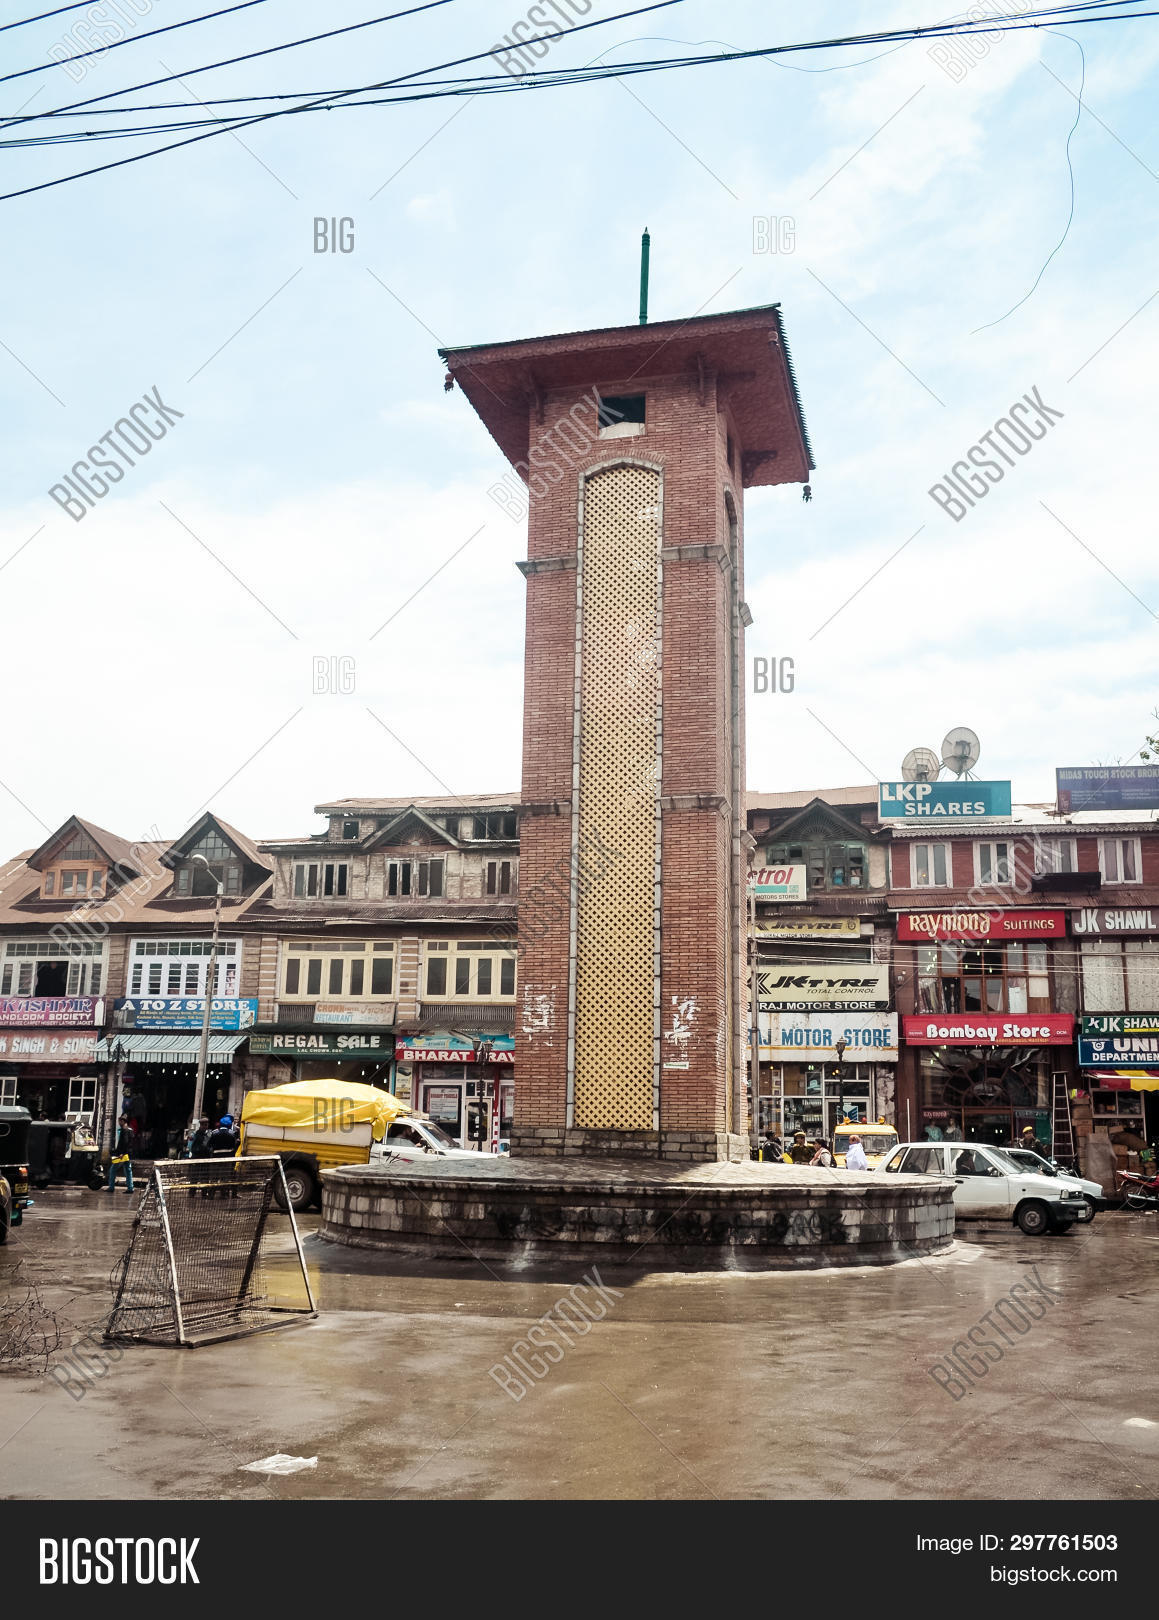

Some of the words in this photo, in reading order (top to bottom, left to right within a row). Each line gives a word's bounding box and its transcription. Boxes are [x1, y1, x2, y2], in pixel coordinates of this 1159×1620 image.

[1060, 769, 1082, 780] MIDAS
[1084, 769, 1109, 779] TOUCH
[1110, 768, 1136, 779] STOCK
[882, 784, 932, 801] LKP
[904, 801, 985, 815] SHARES
[908, 913, 990, 937] Raymond
[1003, 919, 1055, 930] SUITINGS
[1074, 908, 1101, 934] JK
[1105, 910, 1157, 930] SHAWL
[120, 1000, 136, 1011] A
[140, 1000, 166, 1011] TO
[169, 1000, 182, 1011] Z
[787, 1002, 831, 1010] MOTOR
[834, 1001, 876, 1010] STORE
[49, 1013, 92, 1021] SOCIETY
[1100, 1018, 1121, 1032] JK
[781, 1028, 832, 1047] MOTOR
[843, 1028, 892, 1047] STORE
[926, 1024, 998, 1042] Bombay
[1003, 1024, 1051, 1038] Store
[11, 1036, 46, 1054] SINGH
[50, 1037, 60, 1054] &
[273, 1034, 329, 1048] REGAL
[337, 1034, 380, 1049] SALE
[403, 1050, 470, 1061] BHARAT
